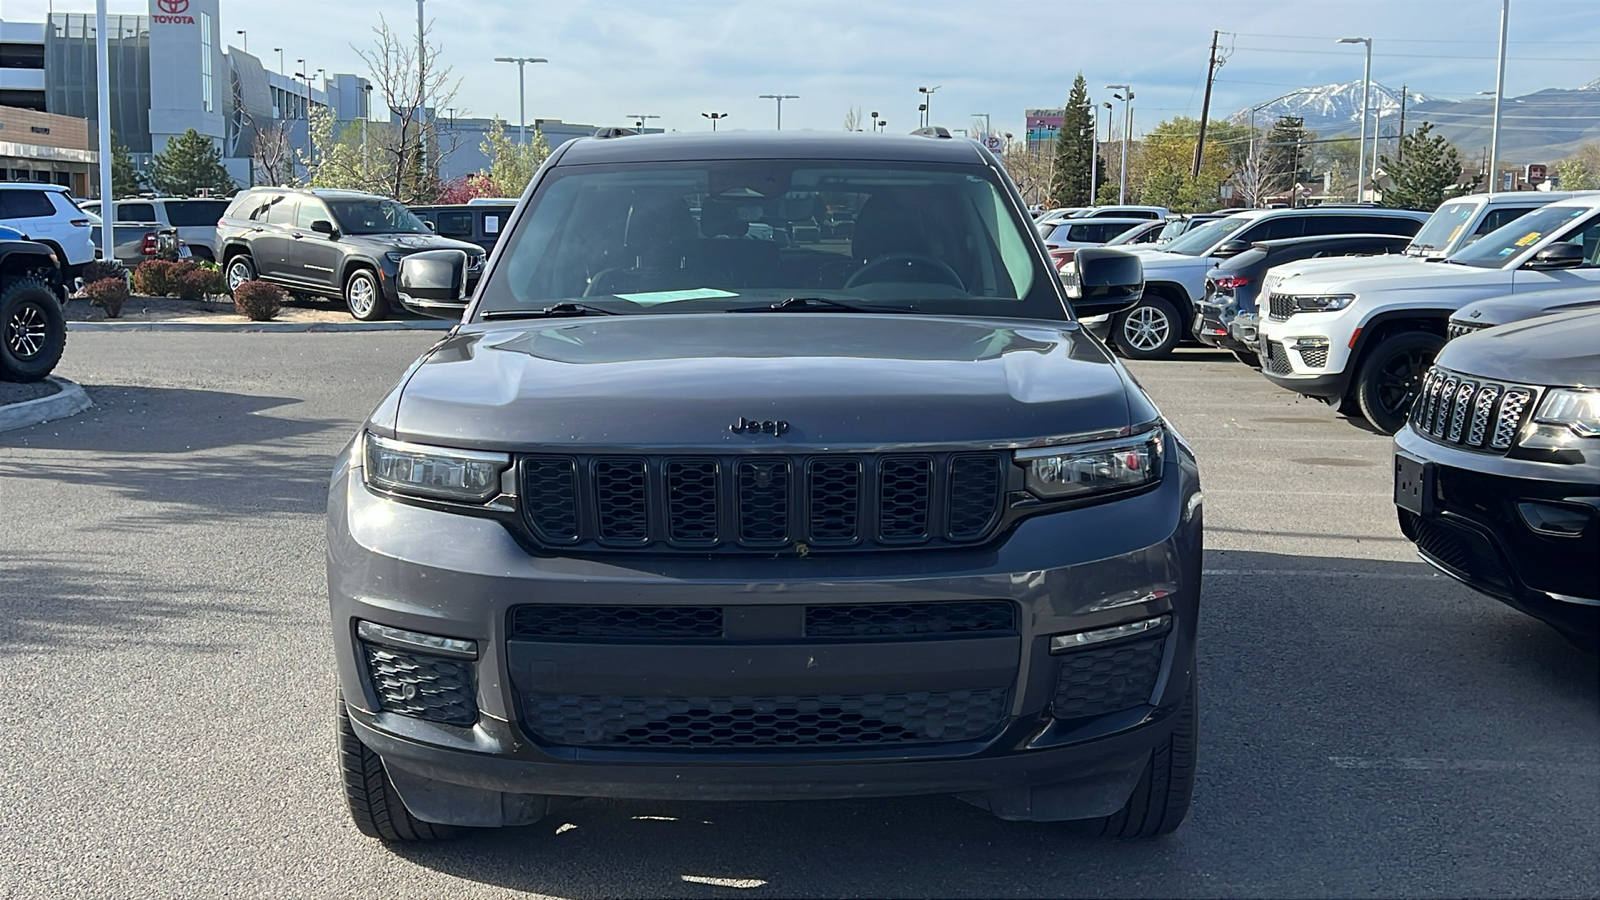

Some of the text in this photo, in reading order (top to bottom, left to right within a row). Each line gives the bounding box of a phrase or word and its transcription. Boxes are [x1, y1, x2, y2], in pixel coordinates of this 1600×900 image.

[152, 15, 195, 25] TOYOTA
[1033, 109, 1066, 117] Atlanti
[729, 416, 790, 437] Jeep
